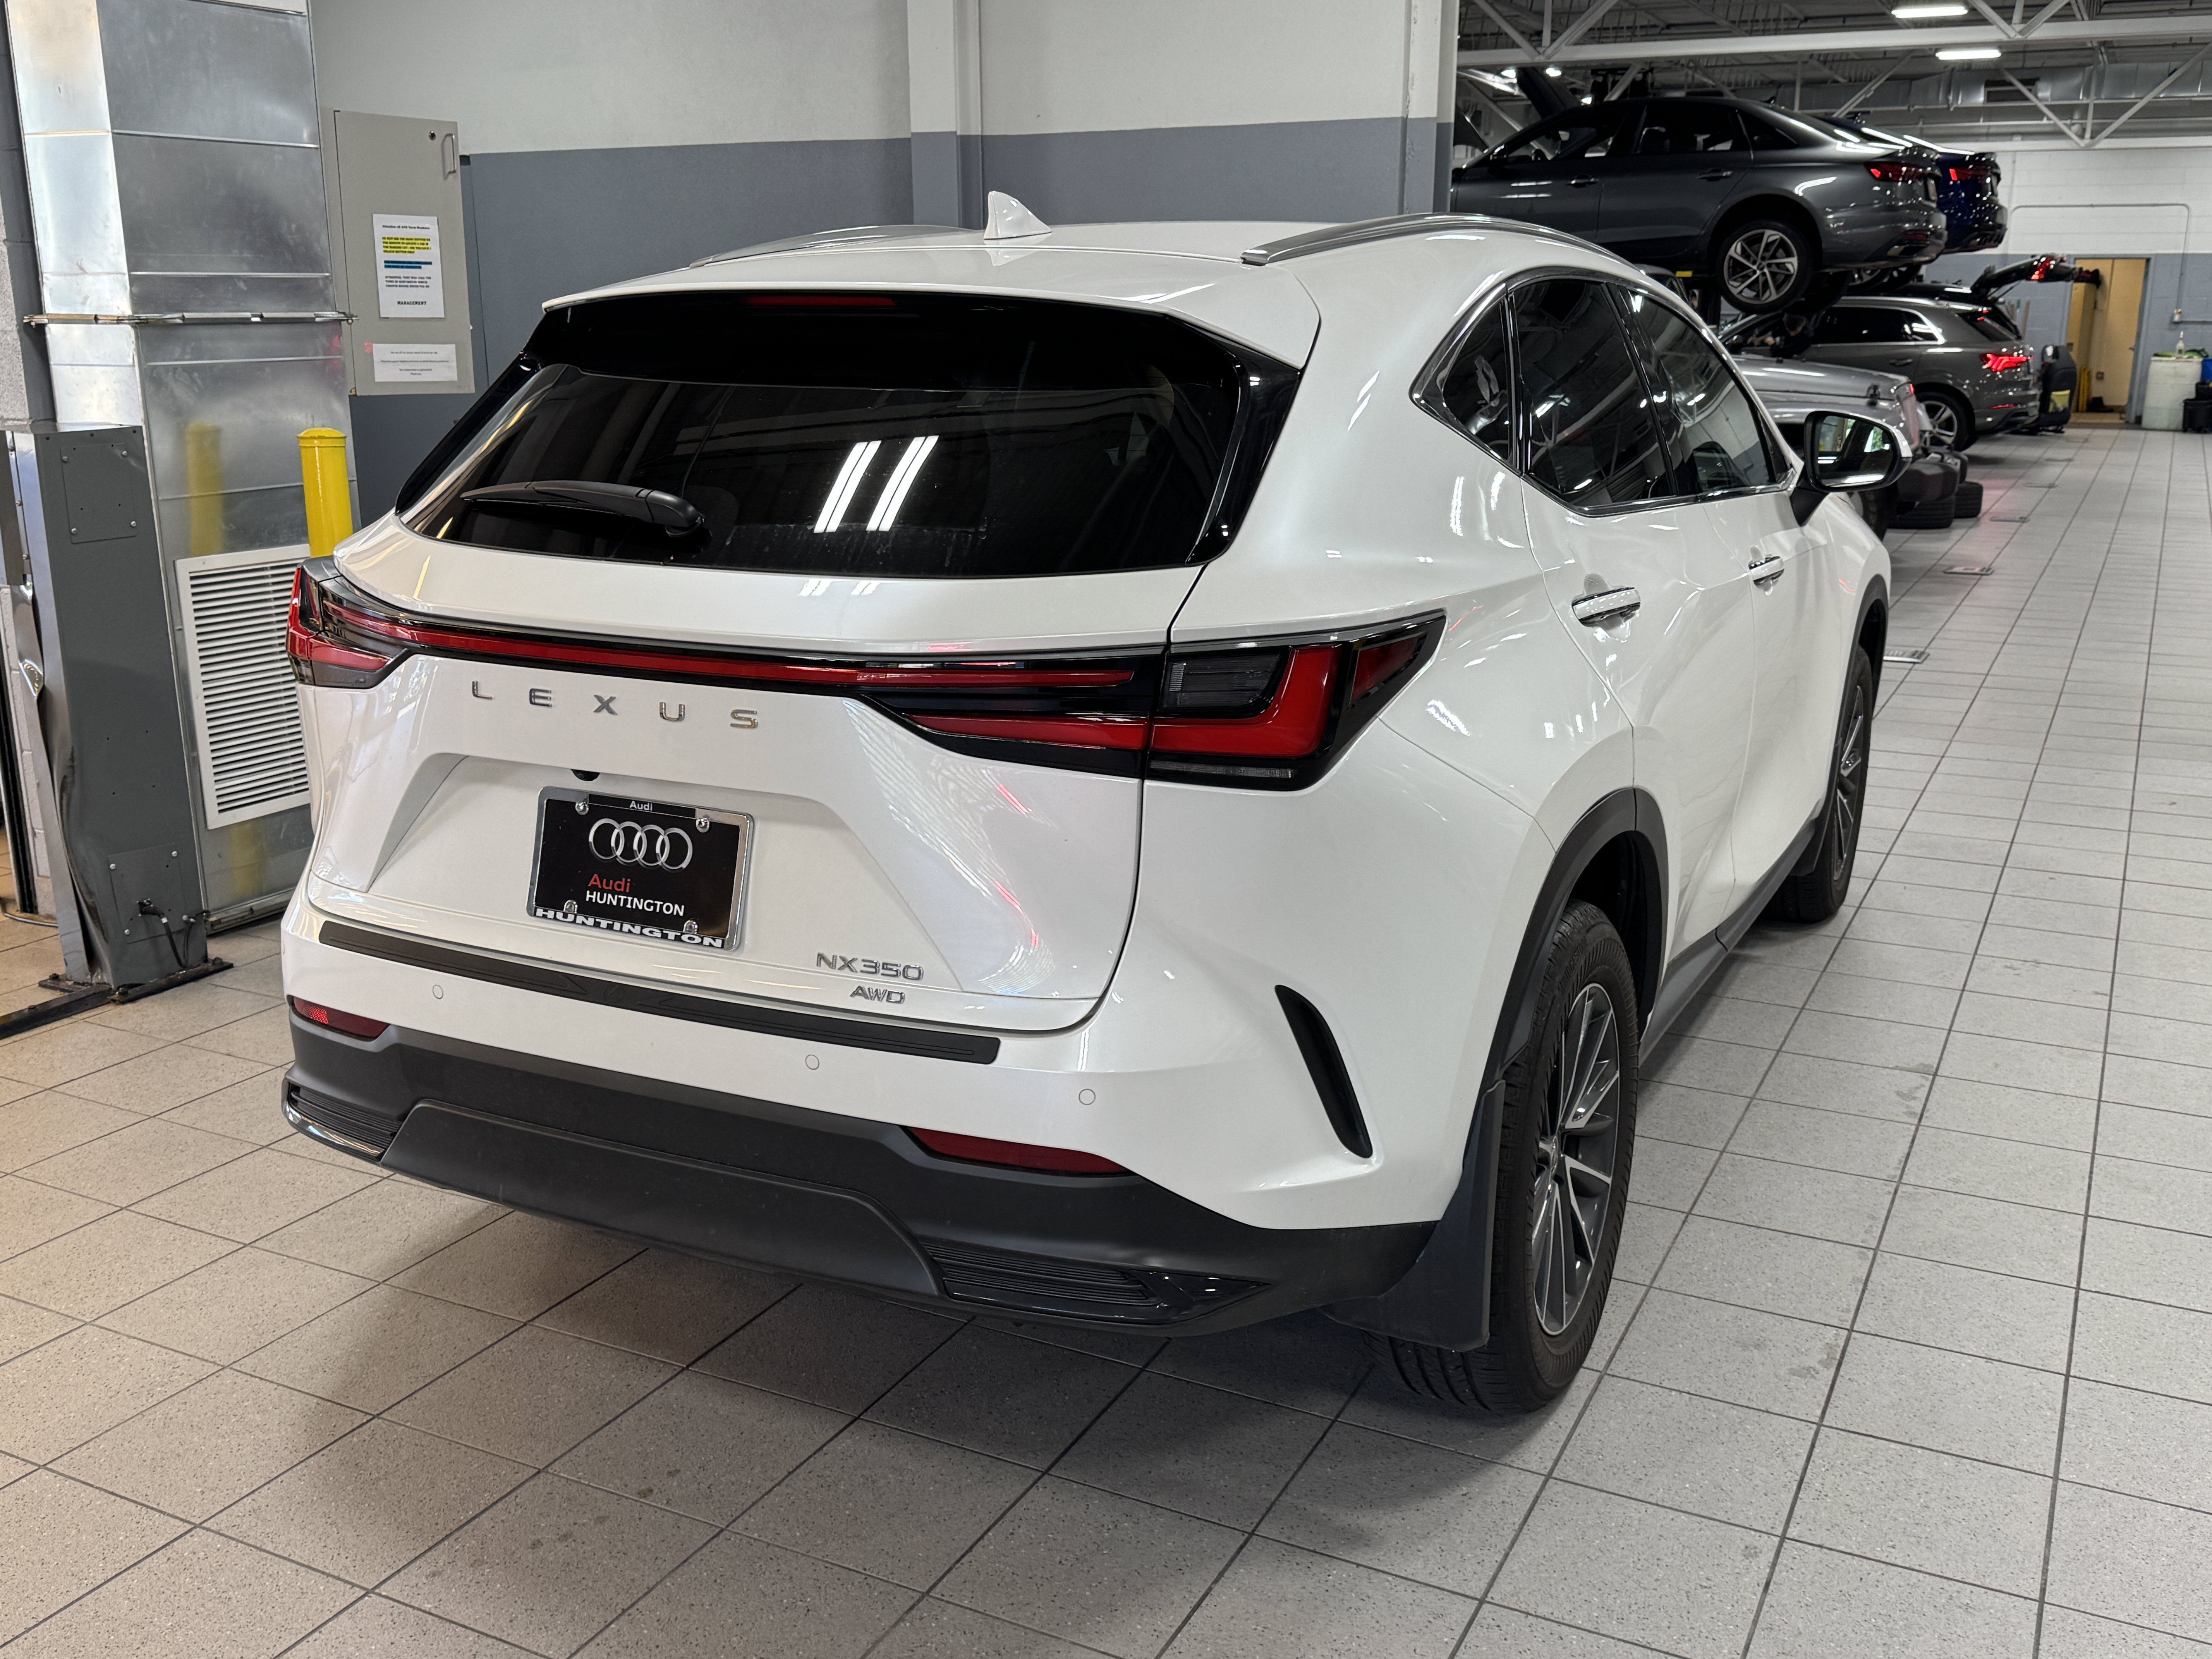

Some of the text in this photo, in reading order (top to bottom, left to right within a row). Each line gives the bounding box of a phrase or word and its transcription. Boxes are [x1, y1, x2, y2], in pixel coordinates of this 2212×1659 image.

[472, 680, 759, 729] LEXUS
[629, 801, 653, 812] Audi
[588, 874, 631, 892] Audi
[586, 890, 685, 917] HUNTINGTON
[536, 908, 724, 948] HUNTINGTON
[816, 952, 924, 981] NX350
[850, 986, 905, 1004] AWD
